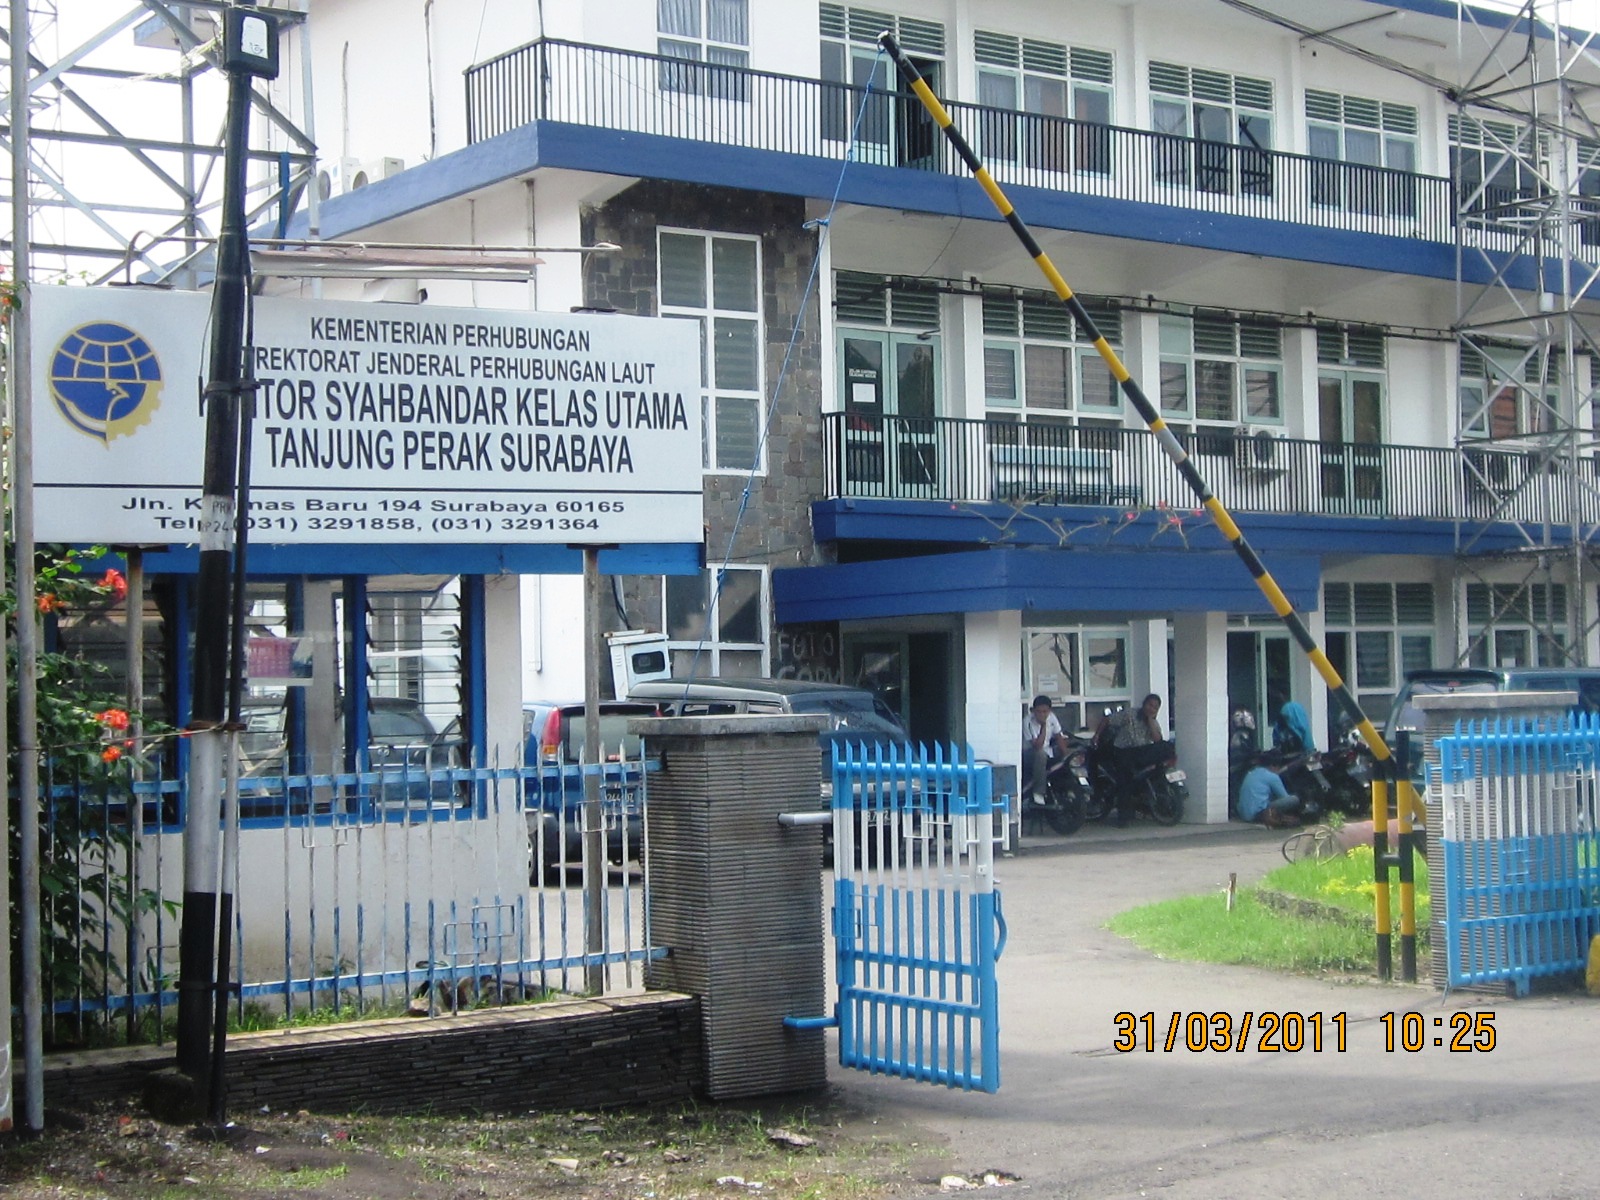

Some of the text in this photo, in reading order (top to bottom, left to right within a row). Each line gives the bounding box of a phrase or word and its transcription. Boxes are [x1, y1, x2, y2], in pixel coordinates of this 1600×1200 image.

[311, 316, 590, 352] KEMENTERIAN PERHUBUNGAN
[241, 345, 656, 384] REKTORAT JENDERAL PERHUBUNGAN LAUT
[198, 376, 689, 430] KTOR SYAHBANDAR KELAS UTAMA
[265, 426, 634, 473] TANJUNG PERAK SURABAYA
[122, 497, 172, 511] Jln.
[305, 499, 368, 512] Baru
[377, 499, 422, 512] 194
[430, 500, 548, 515] Surabaya
[555, 500, 625, 513] 60165
[153, 516, 201, 532] Tel
[308, 517, 423, 532] 3291858,
[431, 517, 492, 533] (031)
[500, 518, 600, 530] 3291364
